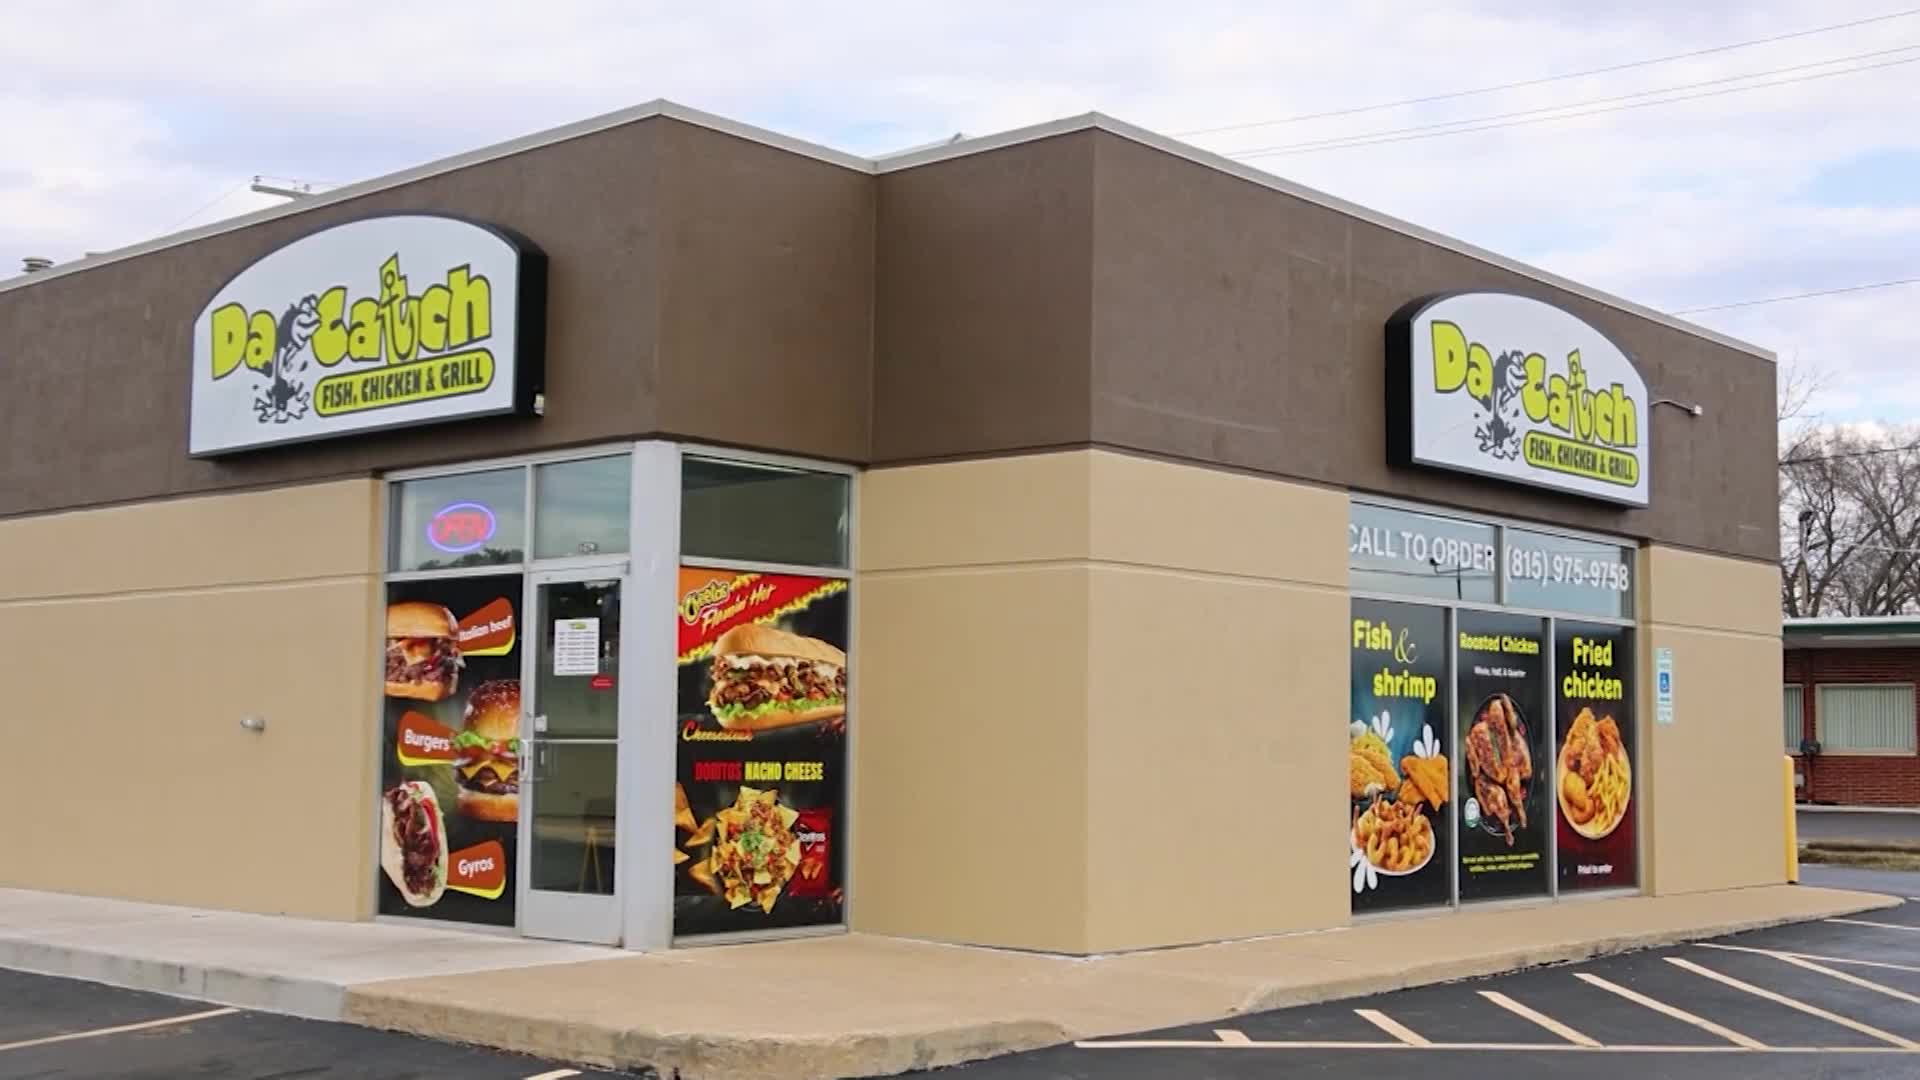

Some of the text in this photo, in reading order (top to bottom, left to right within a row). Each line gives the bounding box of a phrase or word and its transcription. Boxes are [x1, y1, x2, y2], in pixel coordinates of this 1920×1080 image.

[211, 252, 491, 380] Da Catch
[322, 358, 483, 409] FISH, CHICKEN & GRILL
[1431, 320, 1637, 448] Da Catch
[1530, 437, 1633, 480] FISH, CHICKEN & GRILL
[1348, 523, 1629, 592] CALL TO ORDER (815) 975-9758
[750, 583, 776, 606] Hot
[490, 615, 512, 632] beef
[1353, 619, 1418, 664] Fish &
[1460, 632, 1539, 654] Roasted Chicken
[1572, 637, 1612, 666] Fried
[1373, 667, 1436, 704] shrimp
[1563, 670, 1623, 700] chicken
[404, 729, 449, 752] Burgers
[694, 761, 824, 781] DORITOS NACHO CHEESE
[458, 856, 494, 877] Gyros
